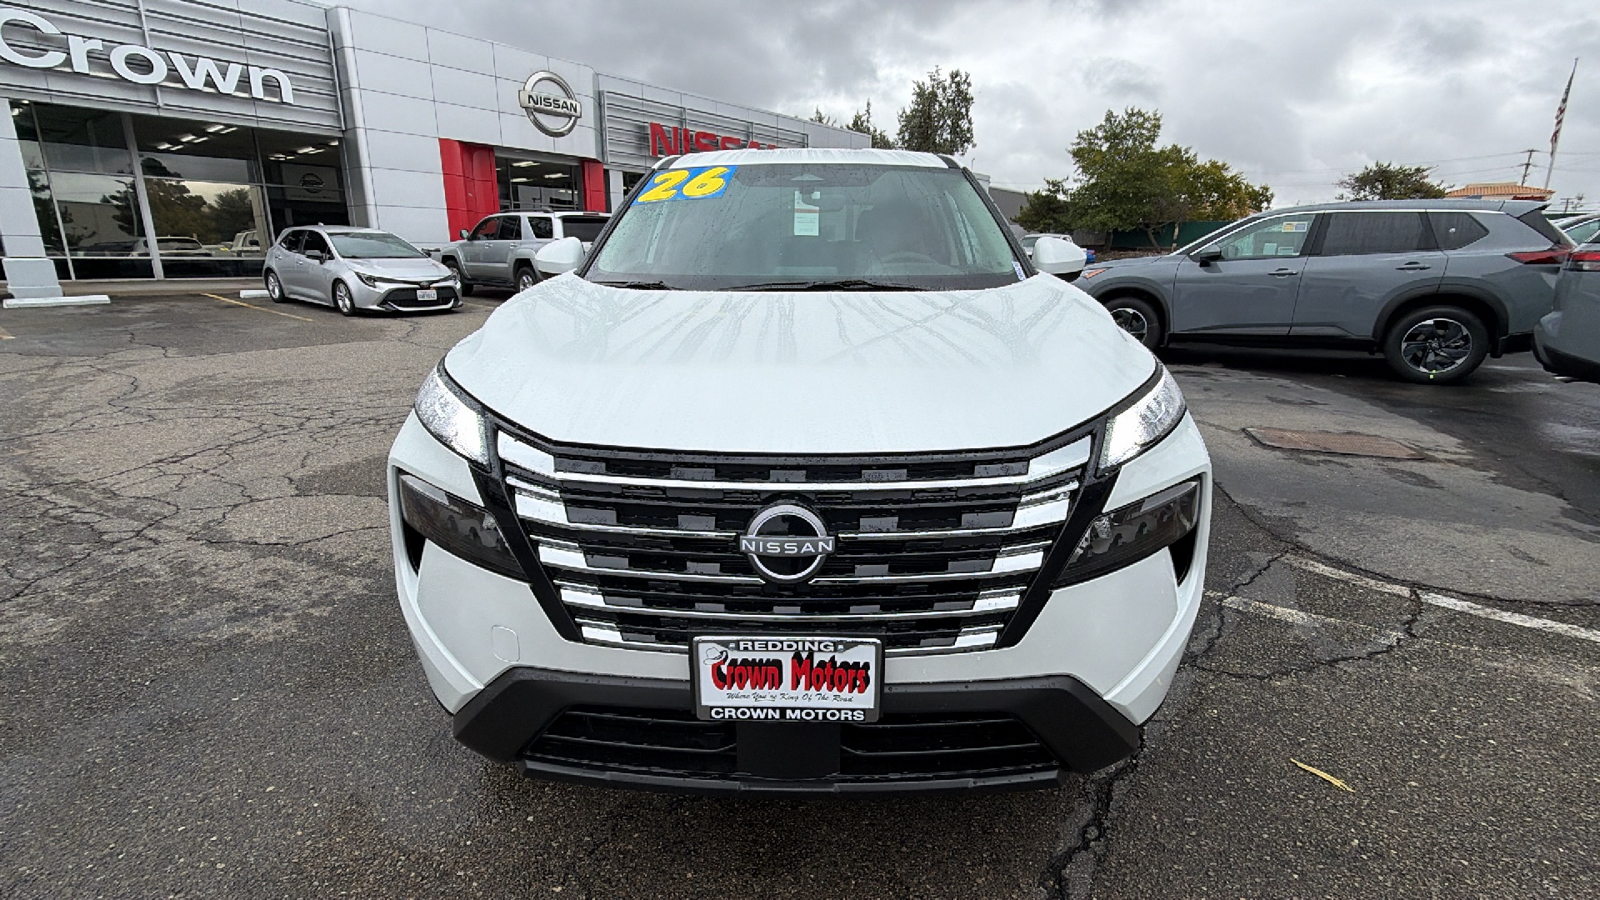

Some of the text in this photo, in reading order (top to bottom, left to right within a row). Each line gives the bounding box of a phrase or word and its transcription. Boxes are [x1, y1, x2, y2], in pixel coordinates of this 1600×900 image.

[0, 7, 295, 105] Crown
[527, 94, 578, 114] NISSAN
[637, 166, 730, 202] 26
[741, 538, 834, 554] NISSAN
[739, 641, 834, 652] REDDING
[711, 653, 870, 694] Crown Motors
[726, 692, 751, 700] Where
[780, 692, 799, 702] King
[801, 693, 813, 702] Of
[815, 693, 829, 701] The
[831, 694, 853, 702] Road
[711, 707, 865, 721] CROWN MOTORS
